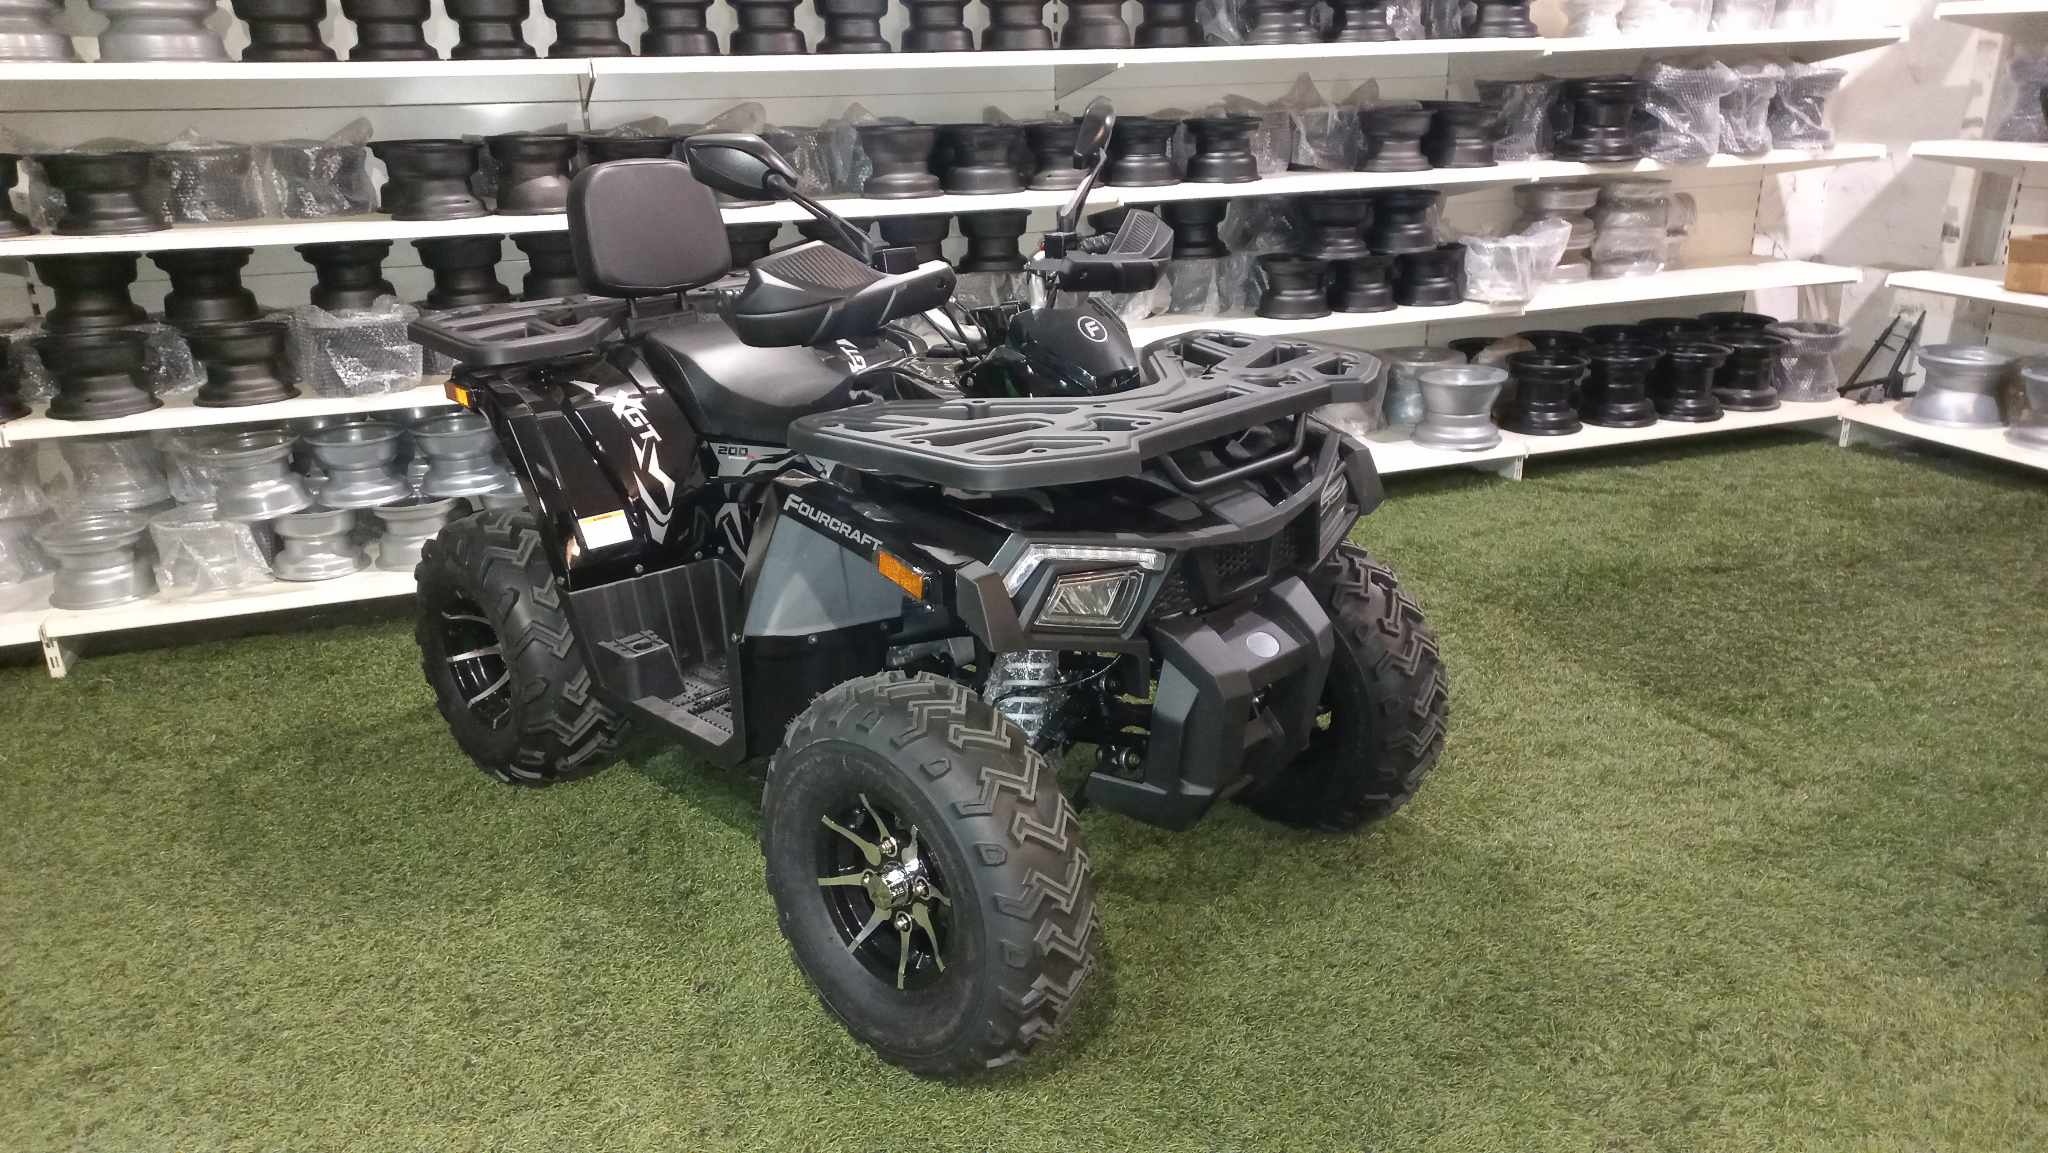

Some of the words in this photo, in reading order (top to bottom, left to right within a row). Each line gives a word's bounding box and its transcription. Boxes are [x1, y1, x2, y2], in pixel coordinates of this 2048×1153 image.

[1085, 321, 1100, 337] F
[598, 389, 662, 441] XGT
[718, 446, 748, 456] 200
[783, 493, 884, 552] FOURCRAFT
